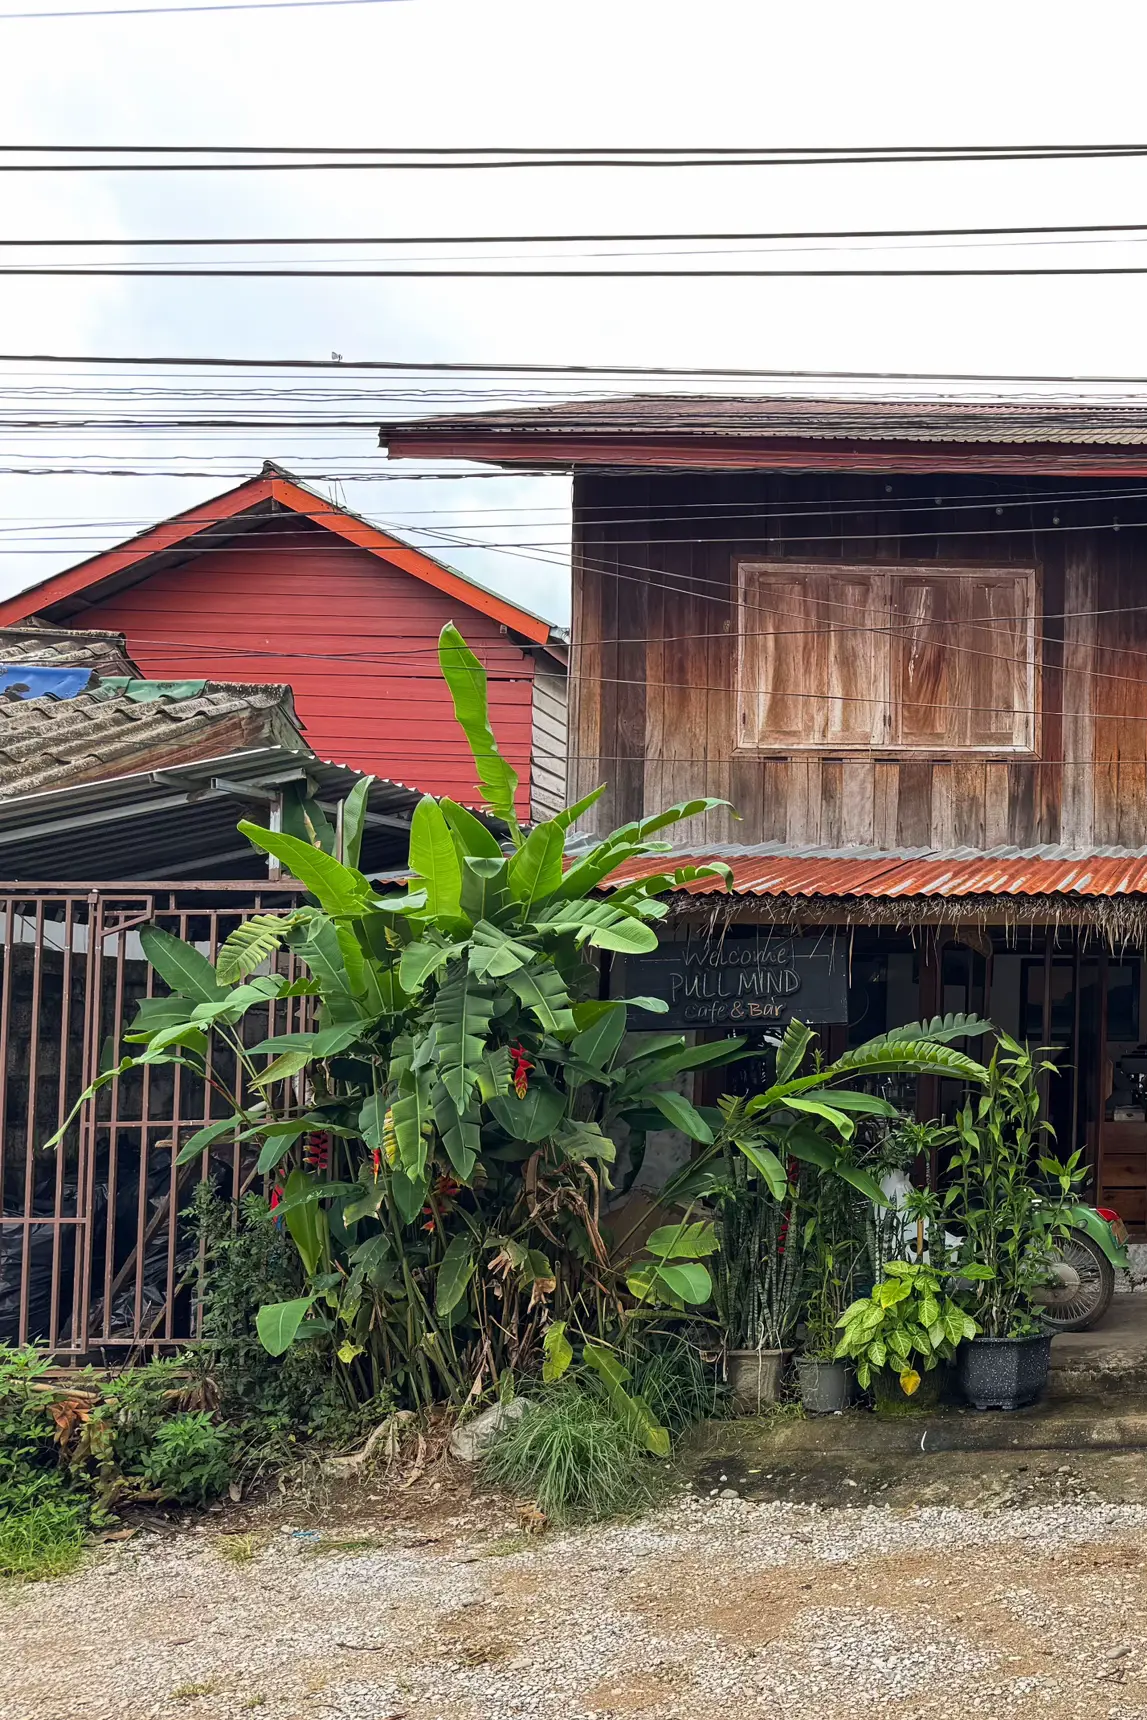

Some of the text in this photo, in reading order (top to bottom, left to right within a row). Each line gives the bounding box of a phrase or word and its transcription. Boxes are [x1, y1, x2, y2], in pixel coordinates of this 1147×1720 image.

[682, 946, 788, 968] Welcome
[669, 969, 802, 1003] PULL MIND
[730, 1000, 745, 1019] &
[748, 1002, 784, 1018] Bar
